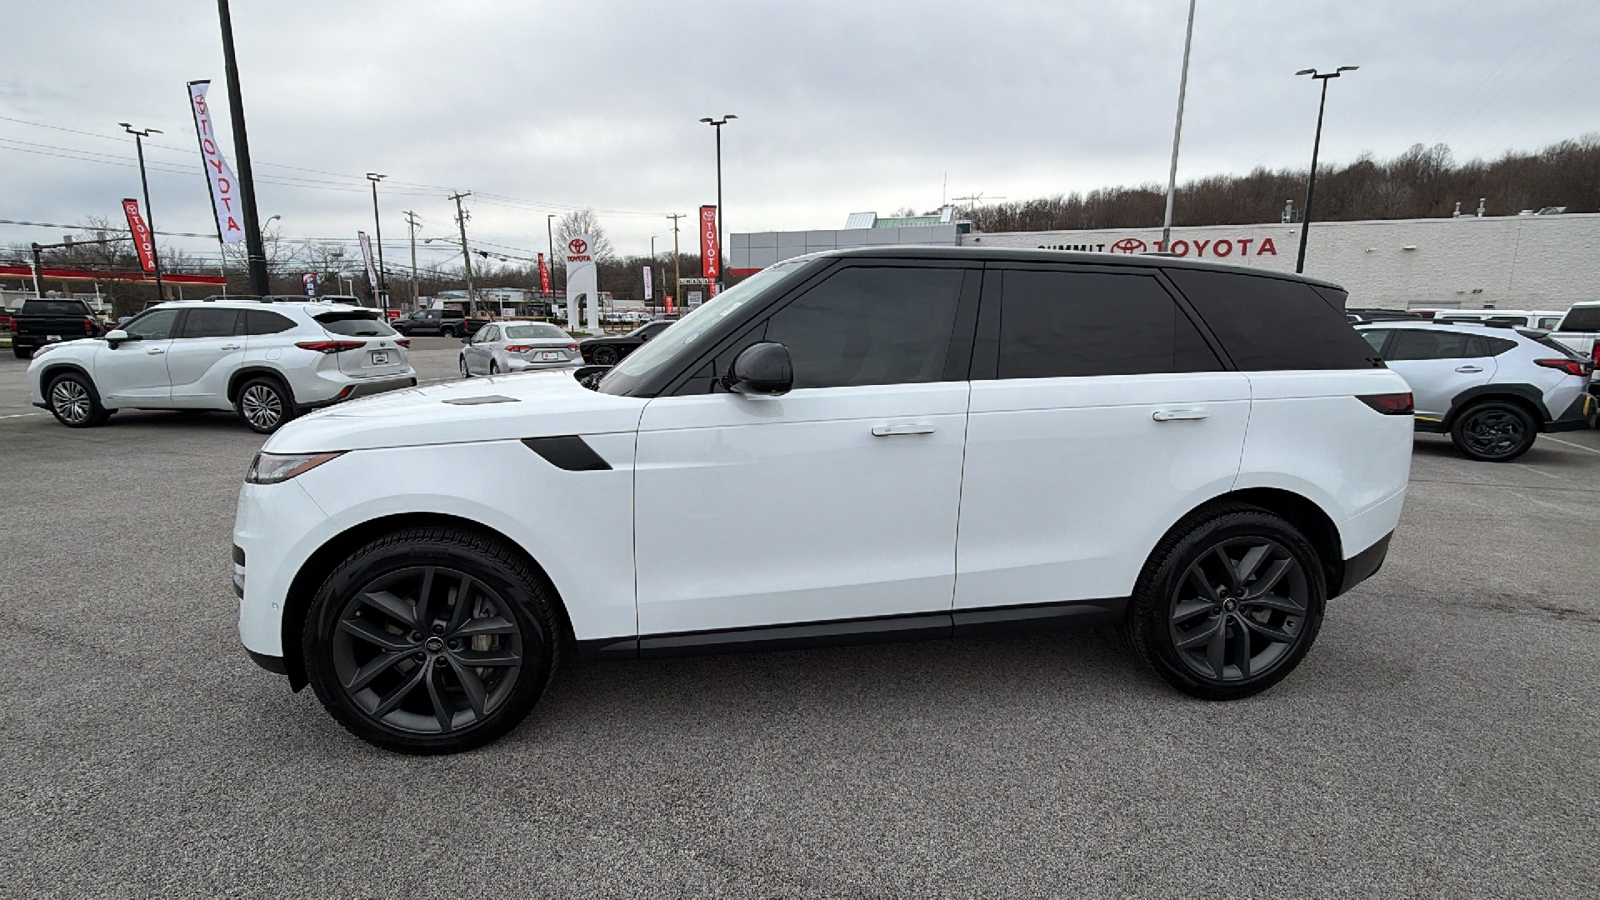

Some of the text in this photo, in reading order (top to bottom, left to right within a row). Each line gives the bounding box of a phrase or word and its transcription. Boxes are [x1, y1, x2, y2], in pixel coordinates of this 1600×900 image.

[201, 119, 241, 232] TOYOTA
[132, 216, 155, 268] TOYOTA
[706, 222, 716, 274] TOYOTA
[1153, 238, 1277, 257] TOYOTA
